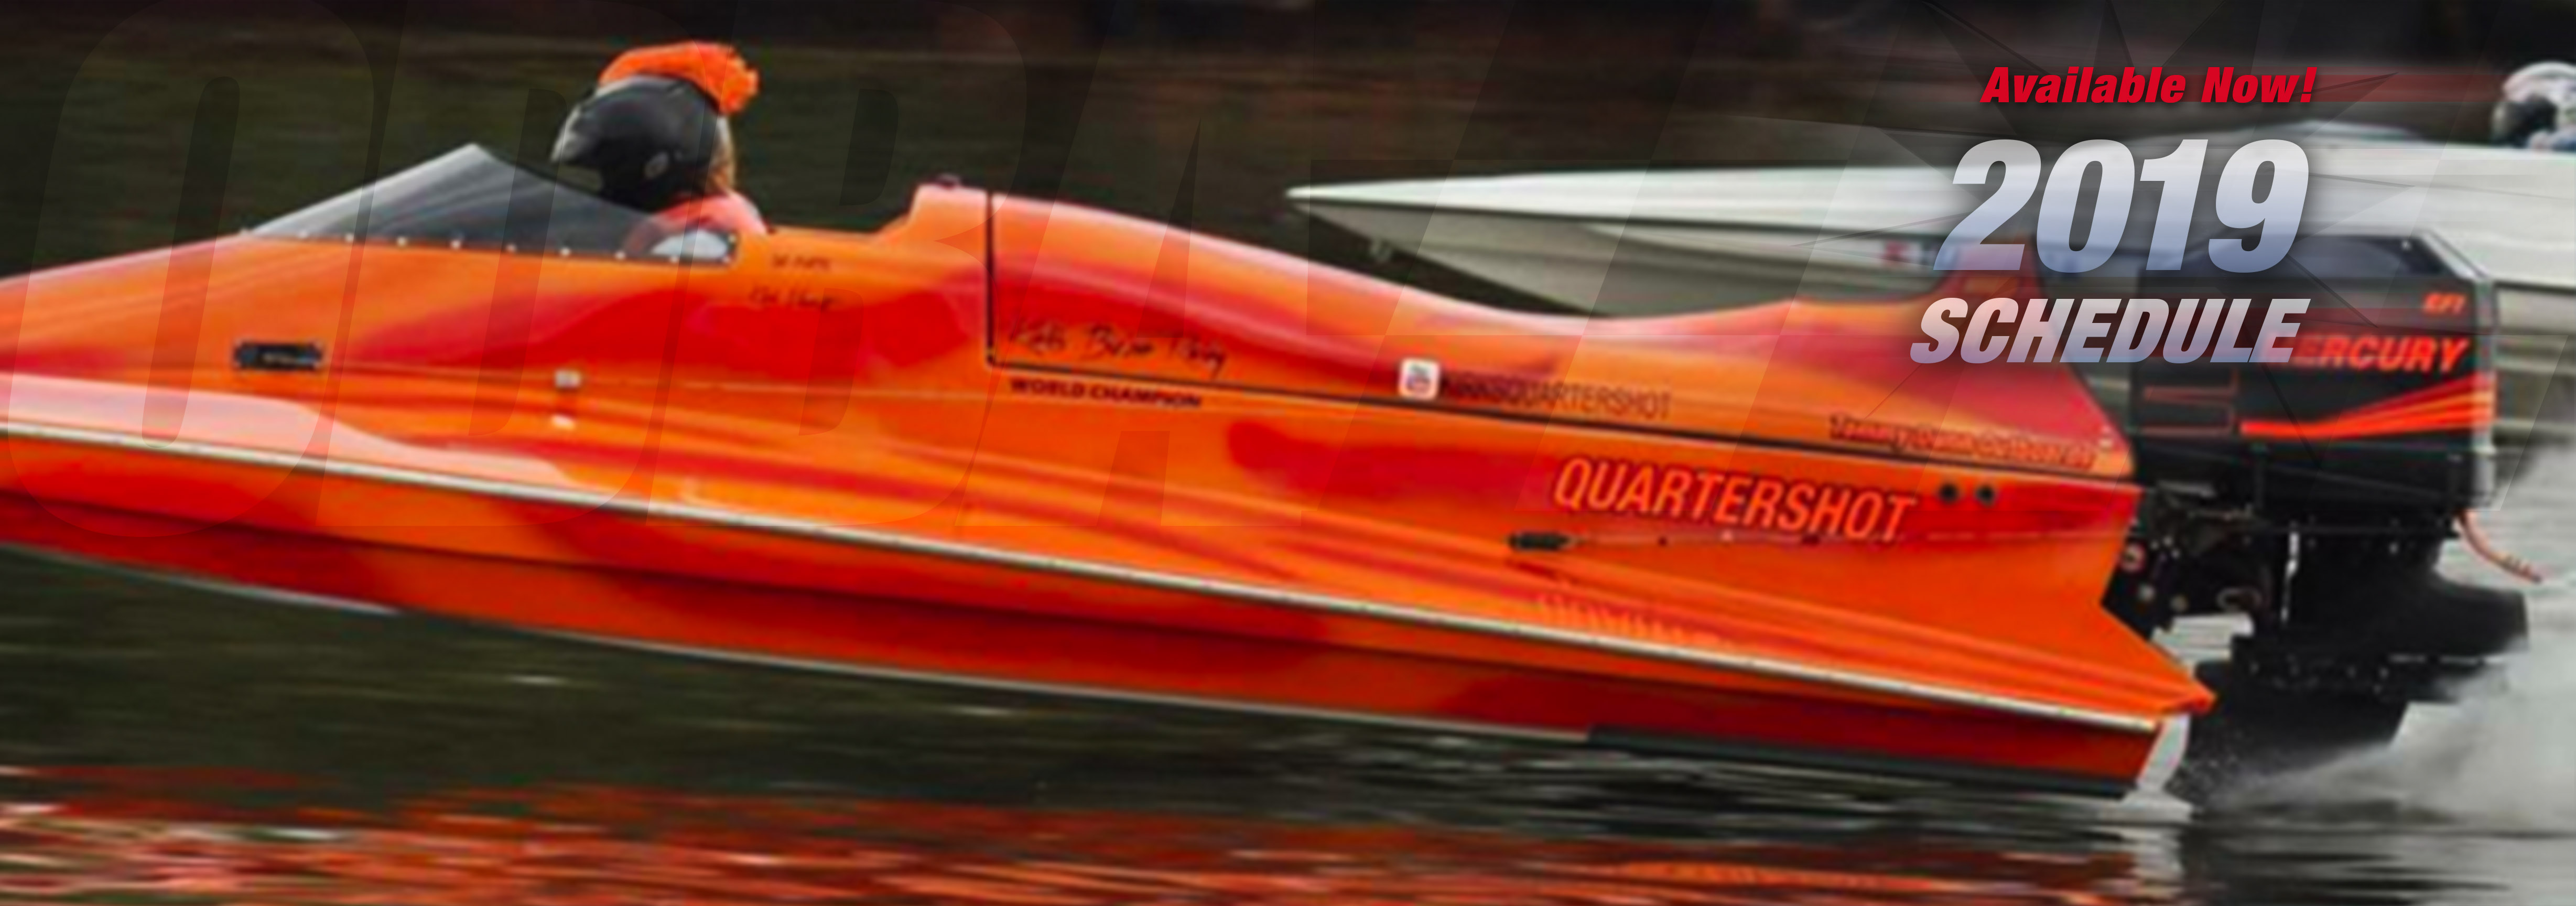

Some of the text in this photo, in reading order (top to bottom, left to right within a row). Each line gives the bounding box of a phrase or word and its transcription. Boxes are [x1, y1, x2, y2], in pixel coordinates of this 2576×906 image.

[2259, 333, 2470, 373] ERCURY
[1009, 376, 1204, 407] WORLD CHAMPION
[1553, 456, 1918, 542] QUARTERSHOT
